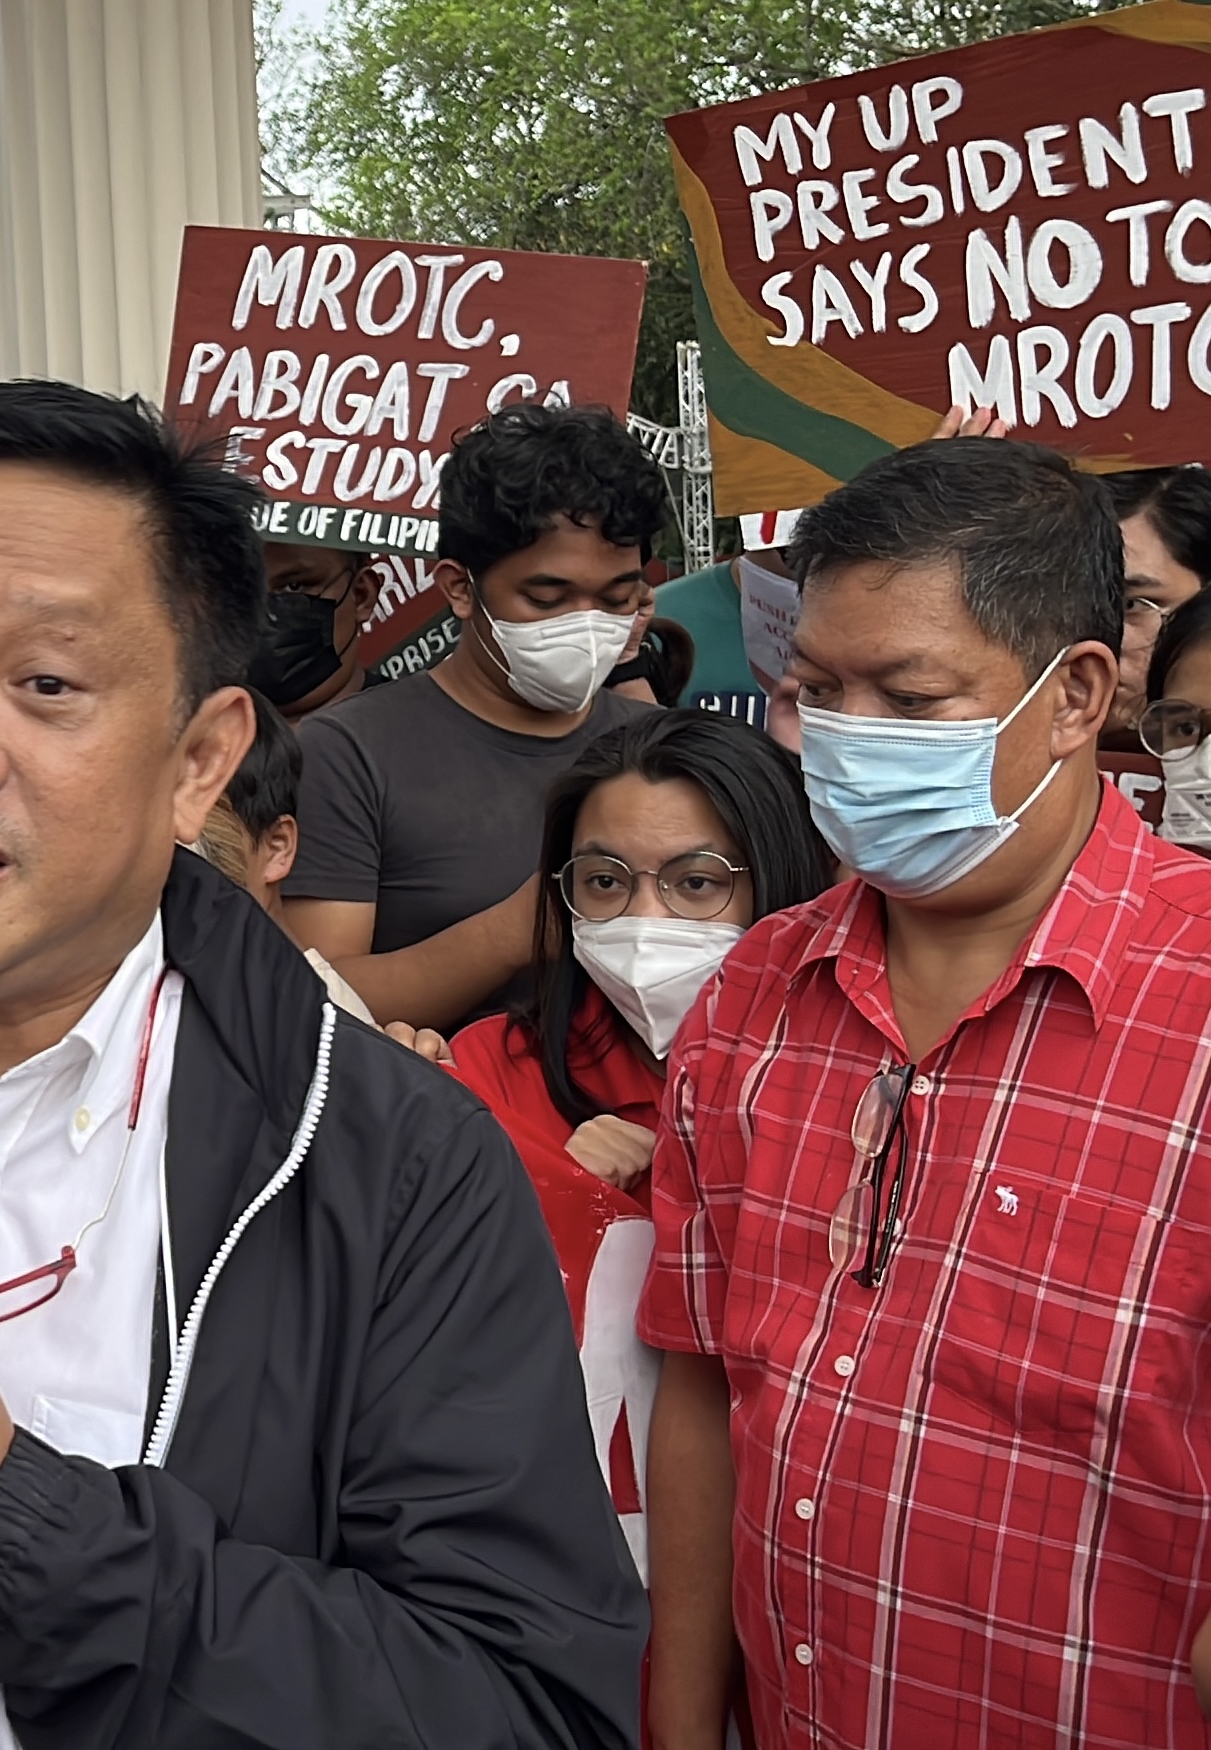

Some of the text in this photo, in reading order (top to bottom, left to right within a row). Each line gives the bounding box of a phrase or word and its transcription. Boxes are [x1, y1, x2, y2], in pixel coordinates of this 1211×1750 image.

[733, 76, 964, 187] MY UP
[749, 88, 1207, 263] PRESIDENT
[231, 243, 521, 357] MROTC,
[760, 199, 1211, 348] SAYS NO TO
[179, 341, 470, 444] PABIGAT
[221, 426, 452, 510] ESTUDY
[297, 505, 337, 539] OF
